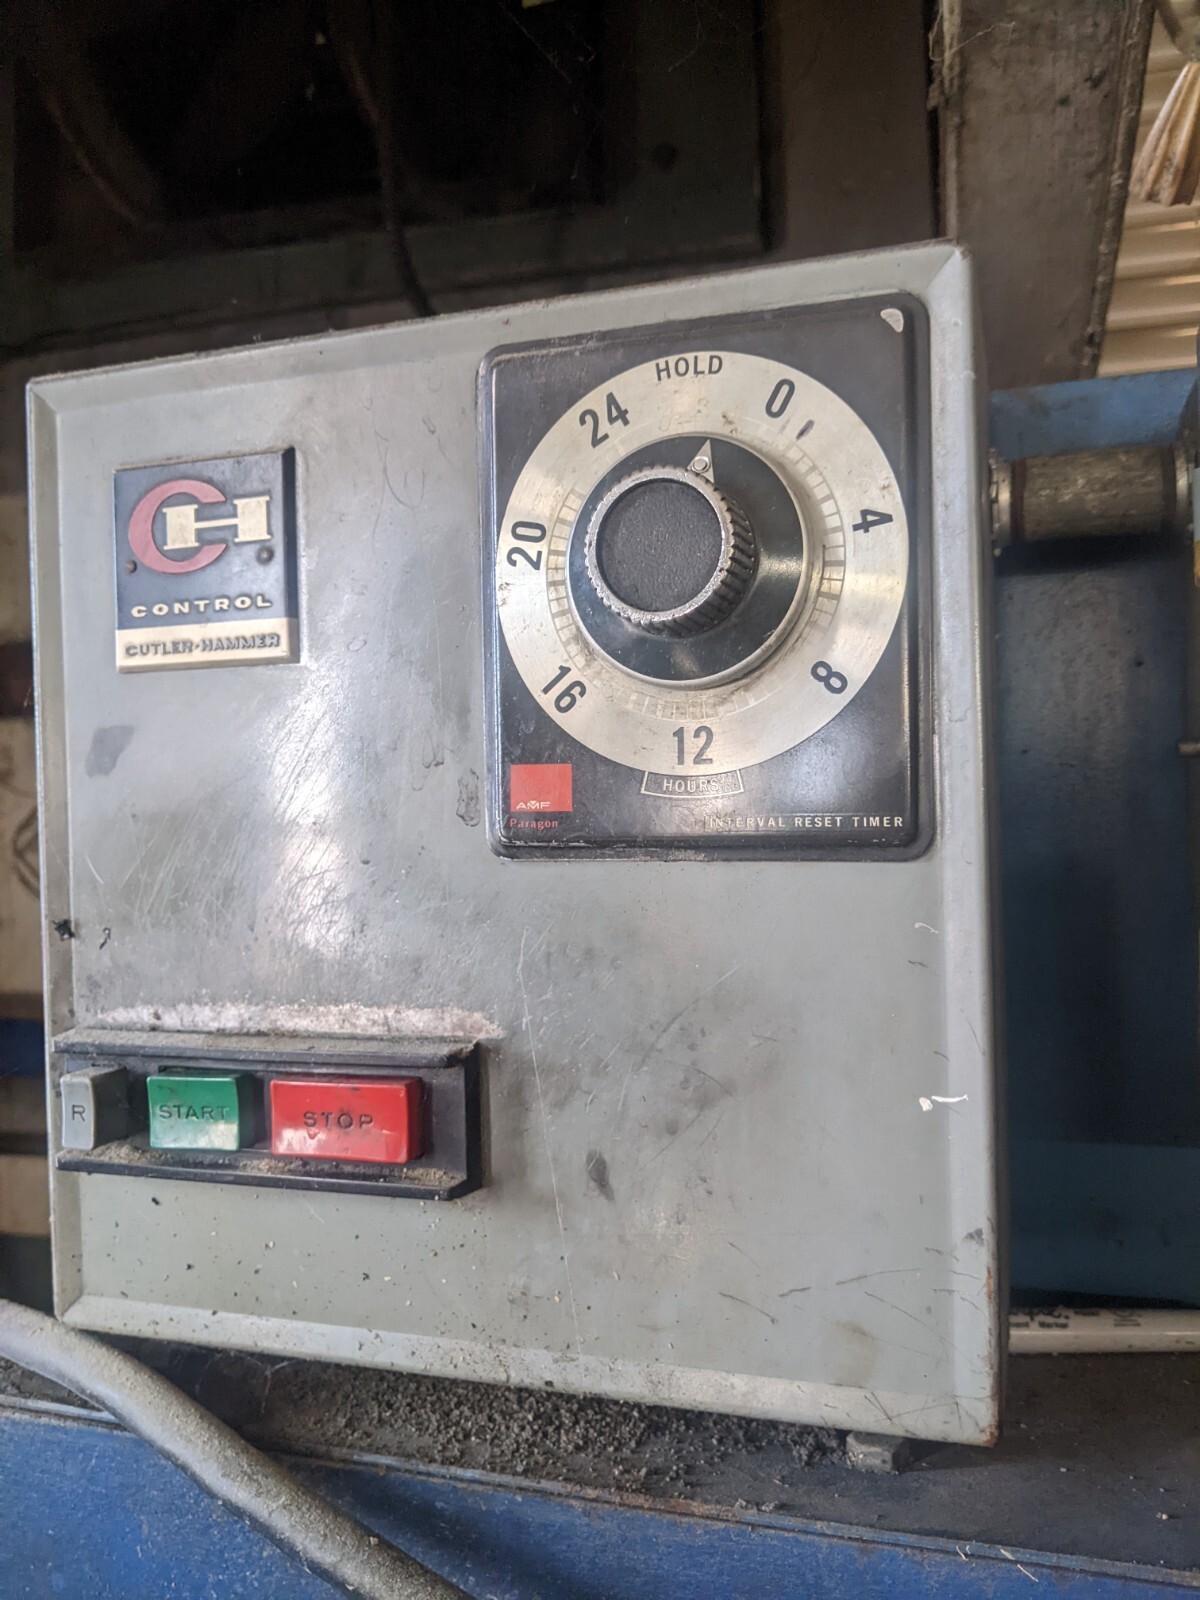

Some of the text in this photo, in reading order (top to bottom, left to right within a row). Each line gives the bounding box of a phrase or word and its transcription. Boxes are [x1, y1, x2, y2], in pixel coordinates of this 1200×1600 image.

[655, 354, 723, 382] HOLD
[765, 377, 796, 419] 0
[578, 392, 631, 448] 24
[851, 507, 894, 535] 4
[506, 519, 547, 571] 20
[130, 595, 272, 618] CONTROL
[541, 664, 587, 714] 16
[810, 660, 849, 695] 8
[672, 725, 714, 766] 12
[662, 777, 720, 794] HOURS
[515, 800, 551, 810] AMF
[509, 818, 559, 831] Paragon
[709, 816, 904, 829] INTERVAL RESET TIMER
[72, 1104, 86, 1121] R
[159, 1104, 230, 1121] START
[303, 1111, 374, 1130] STOP
